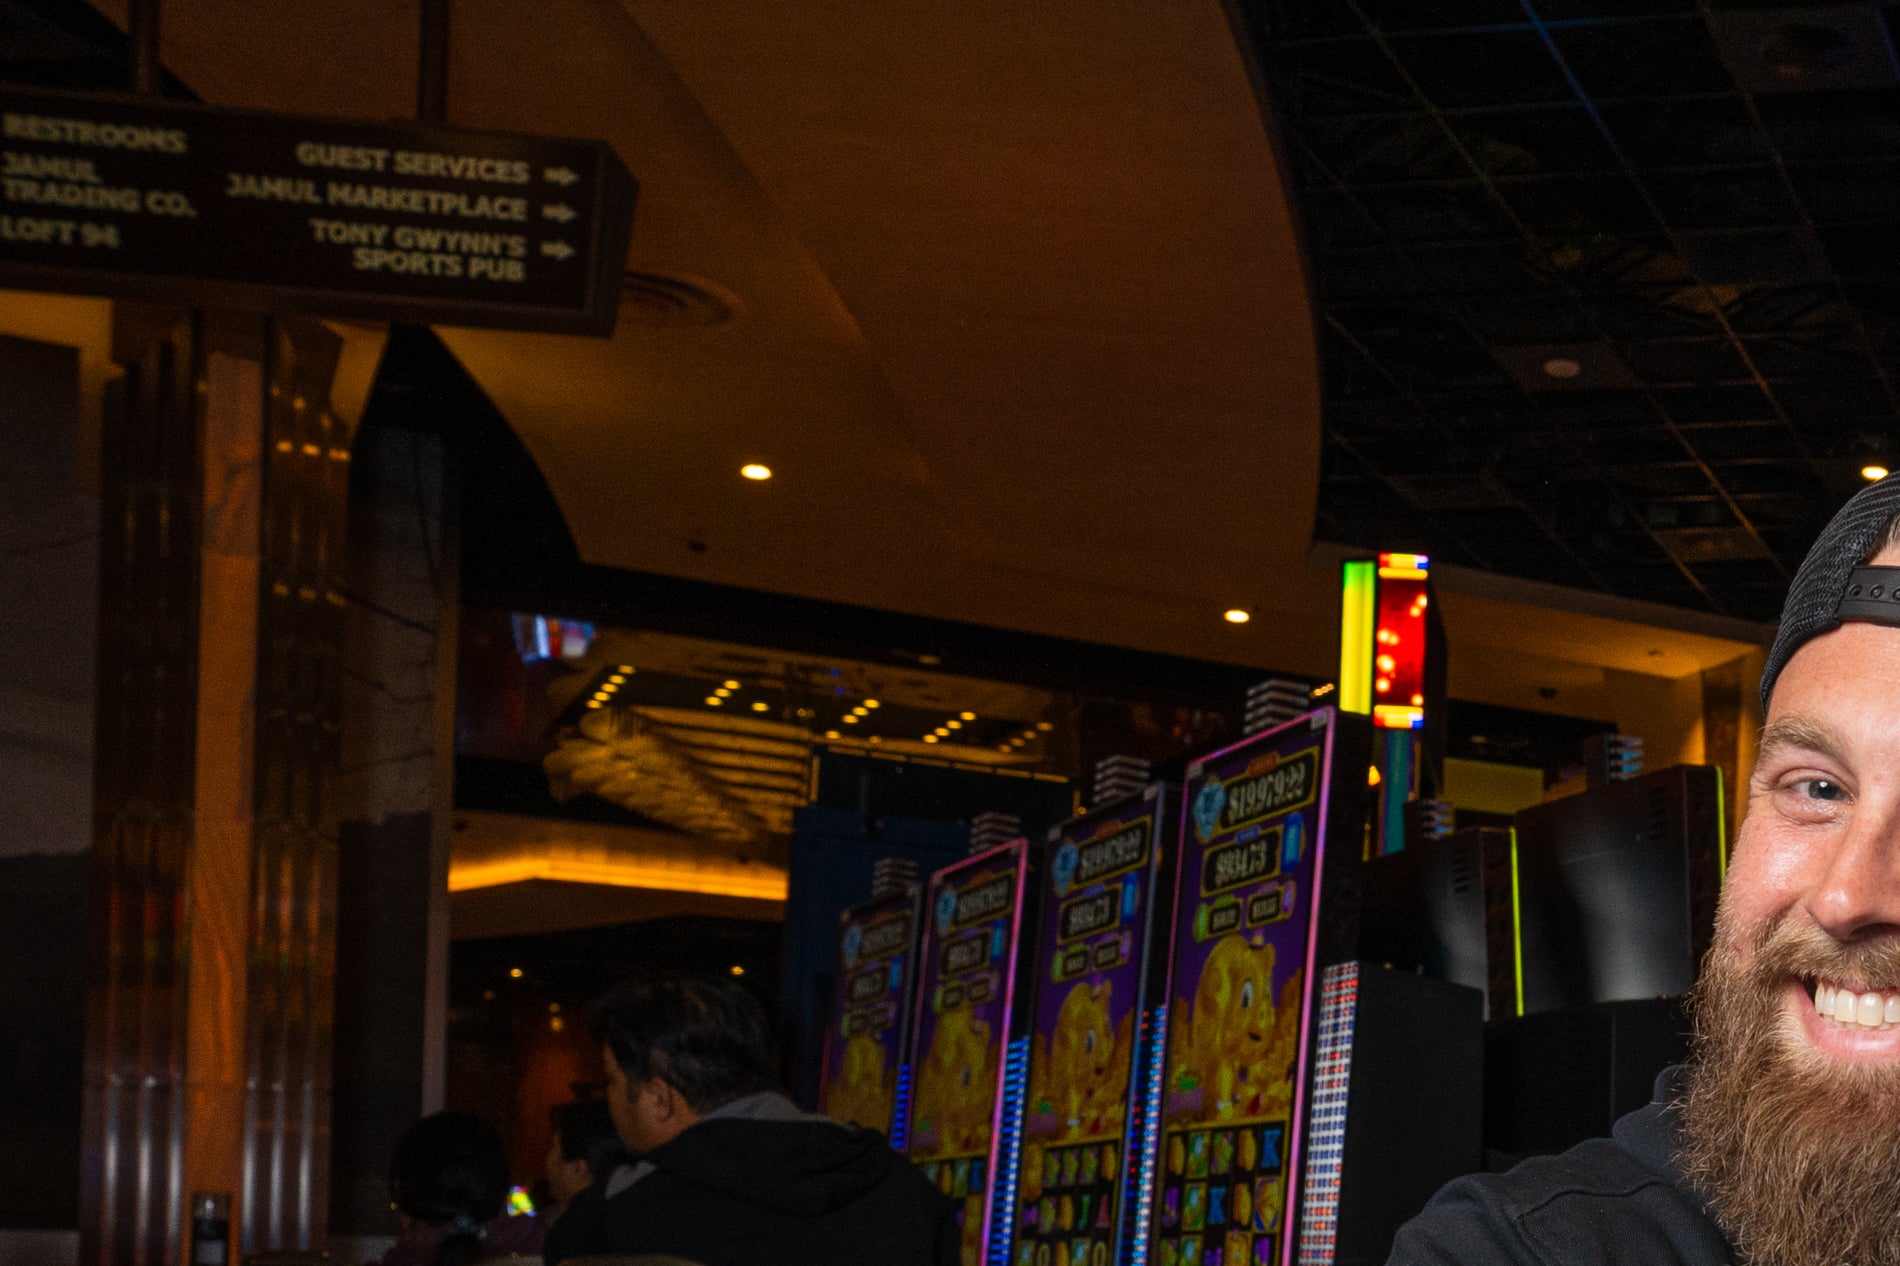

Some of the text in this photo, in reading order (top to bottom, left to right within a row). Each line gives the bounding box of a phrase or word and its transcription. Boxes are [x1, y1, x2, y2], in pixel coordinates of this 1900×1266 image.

[296, 142, 530, 185] GUEST SERVICES
[145, 191, 197, 218] CO.
[226, 172, 528, 222] JAMUL MARKETPLACE
[1, 215, 75, 245] LOFT
[308, 217, 526, 258] TONY GWYNN'S
[352, 247, 526, 282] SPORTS PUB
